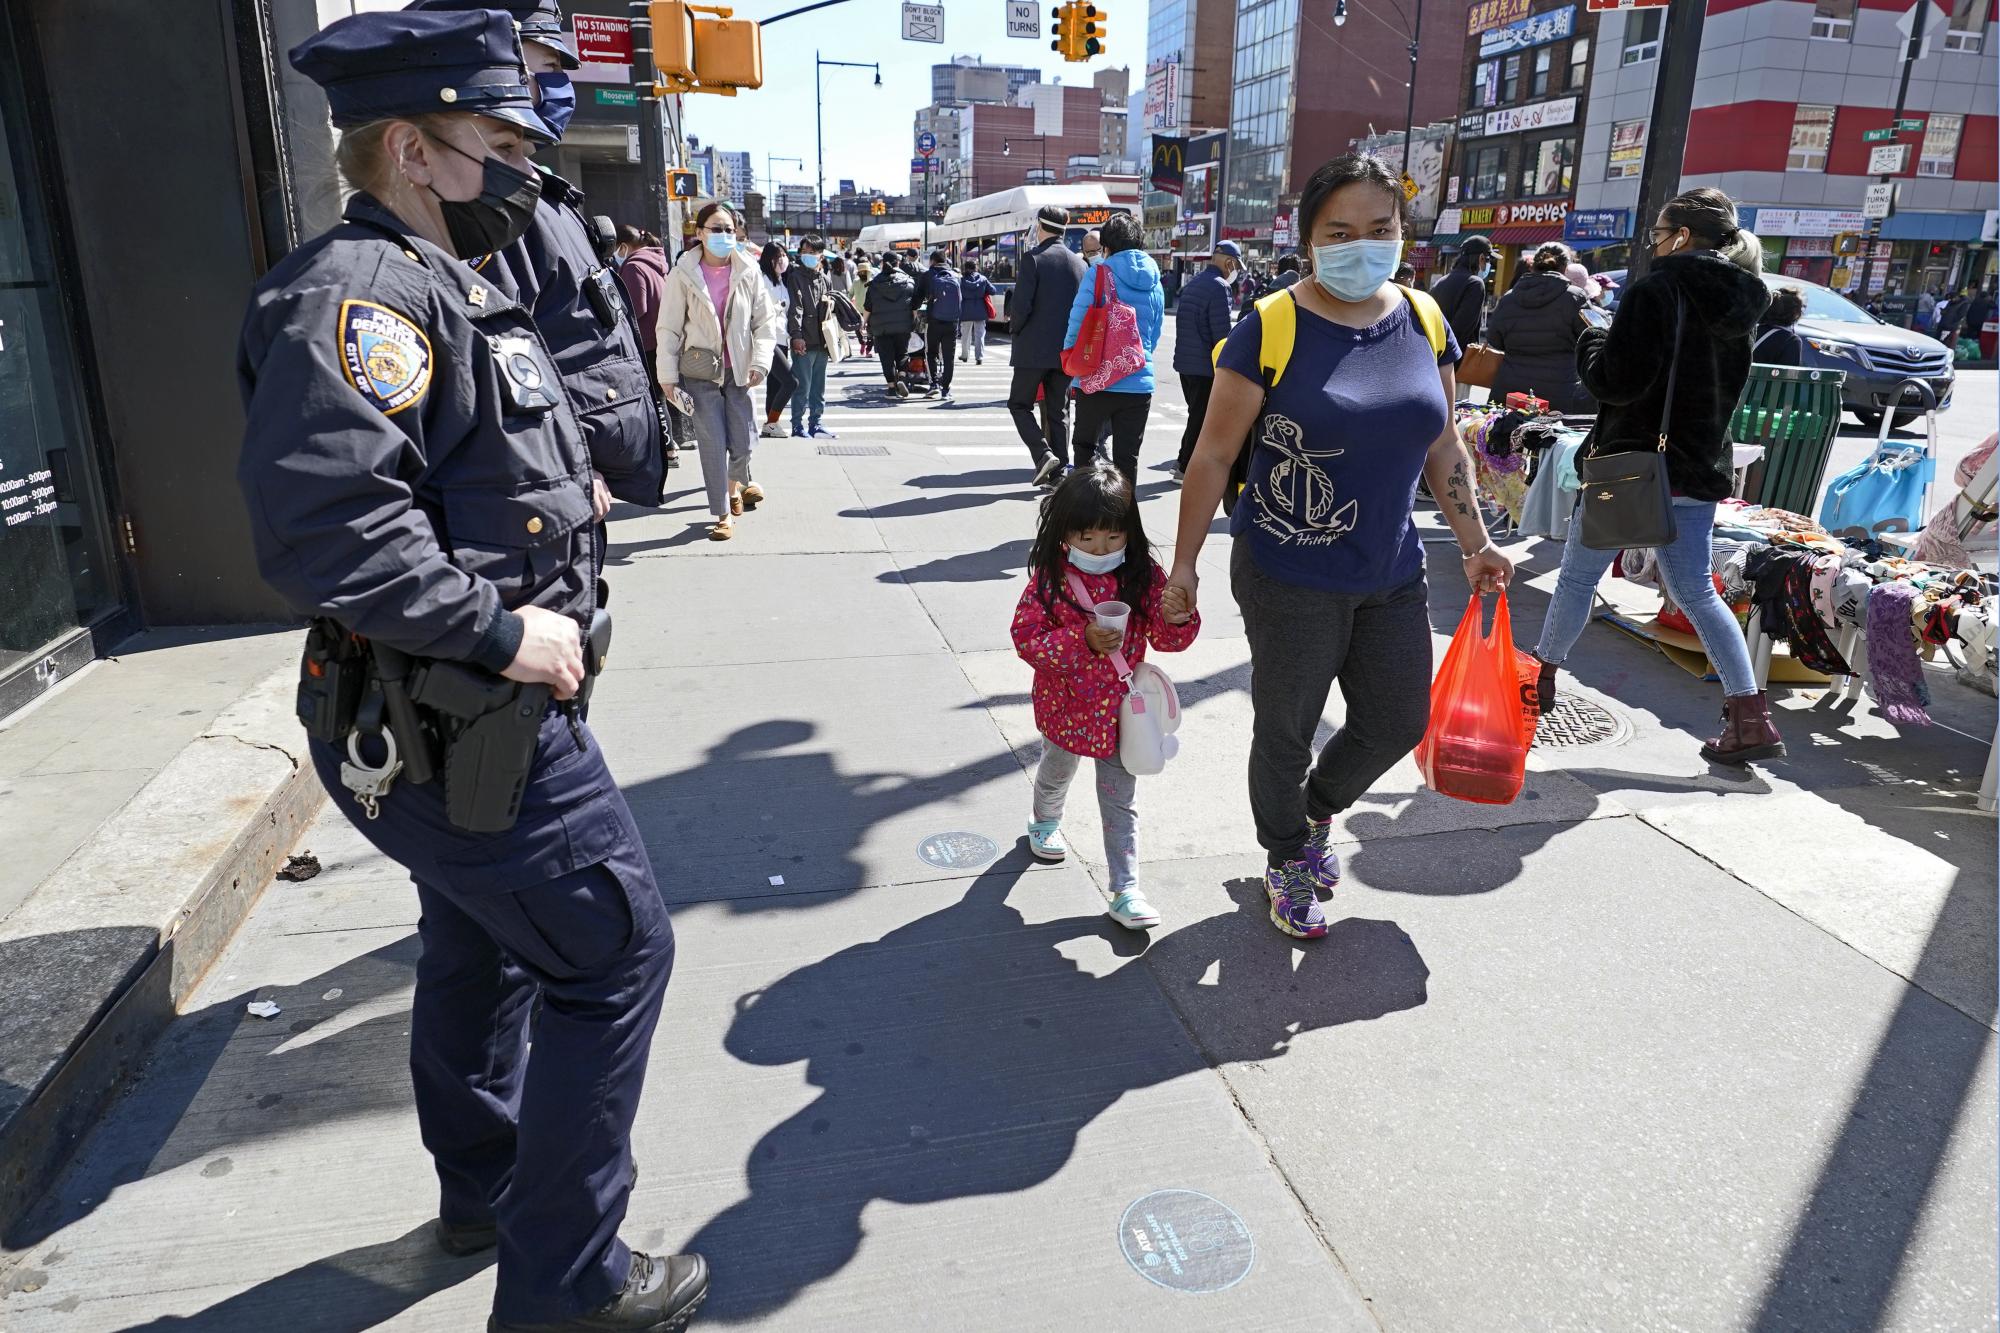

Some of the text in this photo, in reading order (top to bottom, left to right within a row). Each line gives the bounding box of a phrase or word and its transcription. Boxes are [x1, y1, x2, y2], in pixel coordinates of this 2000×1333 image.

[904, 6, 941, 16] DON'T BLOCK
[1016, 8, 1030, 17] NO
[576, 20, 629, 32] NO STANDING
[1009, 21, 1038, 32] TURNS
[580, 32, 611, 42] Anytime
[602, 91, 634, 100] Roosevelt
[1471, 208, 1494, 224] BAKERY
[372, 311, 417, 339] POLICE
[346, 342, 362, 373] CITY
[356, 376, 372, 393] OF
[388, 389, 413, 407] NEW
[28, 470, 52, 483] 9:00pm
[1, 495, 28, 510] 10:00am
[32, 486, 54, 499] 9:00pm
[6, 510, 32, 526] 11:00am
[35, 501, 57, 515] 7:00pm
[1253, 512, 1293, 545] Tommy
[1145, 1212, 1162, 1233] SAFE
[1133, 1228, 1153, 1251] AT&T
[1159, 1240, 1170, 1252] AT
[1162, 1222, 1188, 1261] DISTANCE
[1166, 1251, 1184, 1276] SHOP
